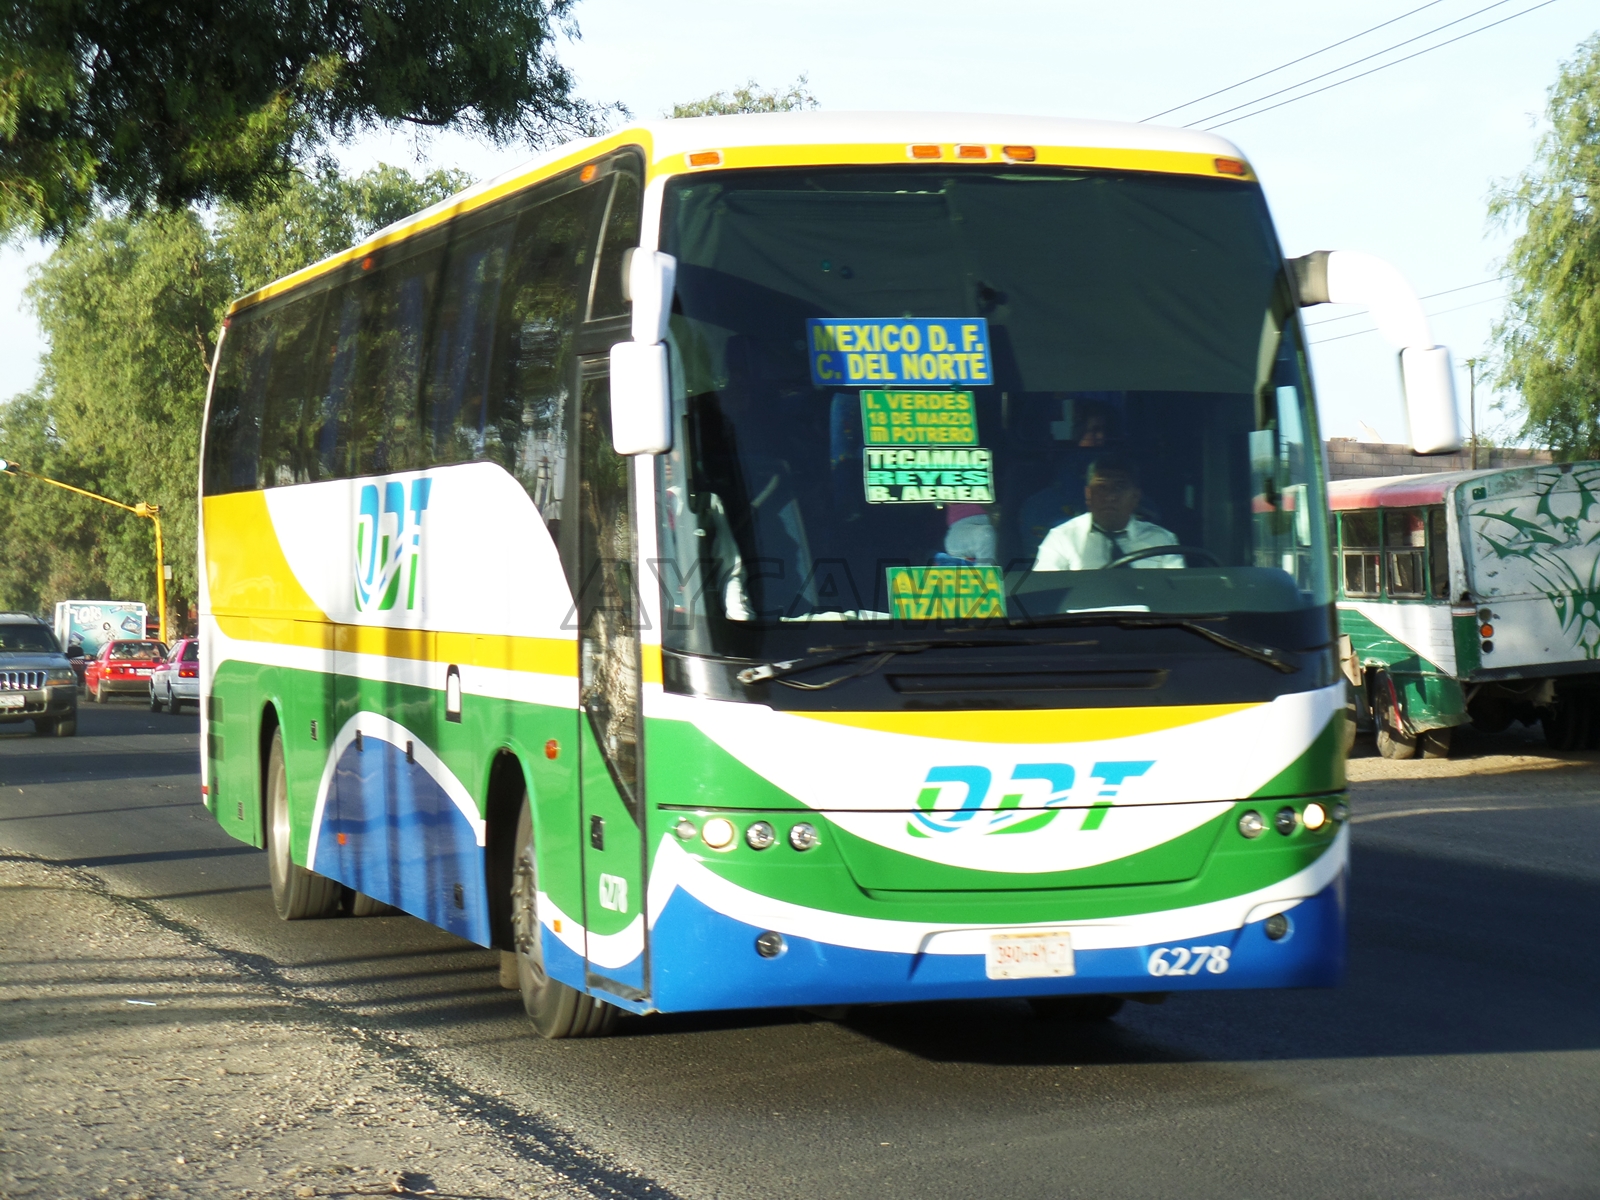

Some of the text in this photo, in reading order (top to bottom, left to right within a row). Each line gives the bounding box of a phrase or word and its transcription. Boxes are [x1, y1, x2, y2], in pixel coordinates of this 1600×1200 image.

[813, 325, 985, 352] MEXICO D. F.
[816, 353, 987, 379] C. DEL NORTE
[885, 394, 970, 410] VERDES
[868, 412, 972, 425] 18 DE MARZO
[892, 427, 974, 442] POTRERO
[867, 450, 988, 469] TECAMAC
[867, 471, 989, 485] REYES
[867, 486, 991, 501] B. AEREA
[1148, 945, 1231, 977] 6278
